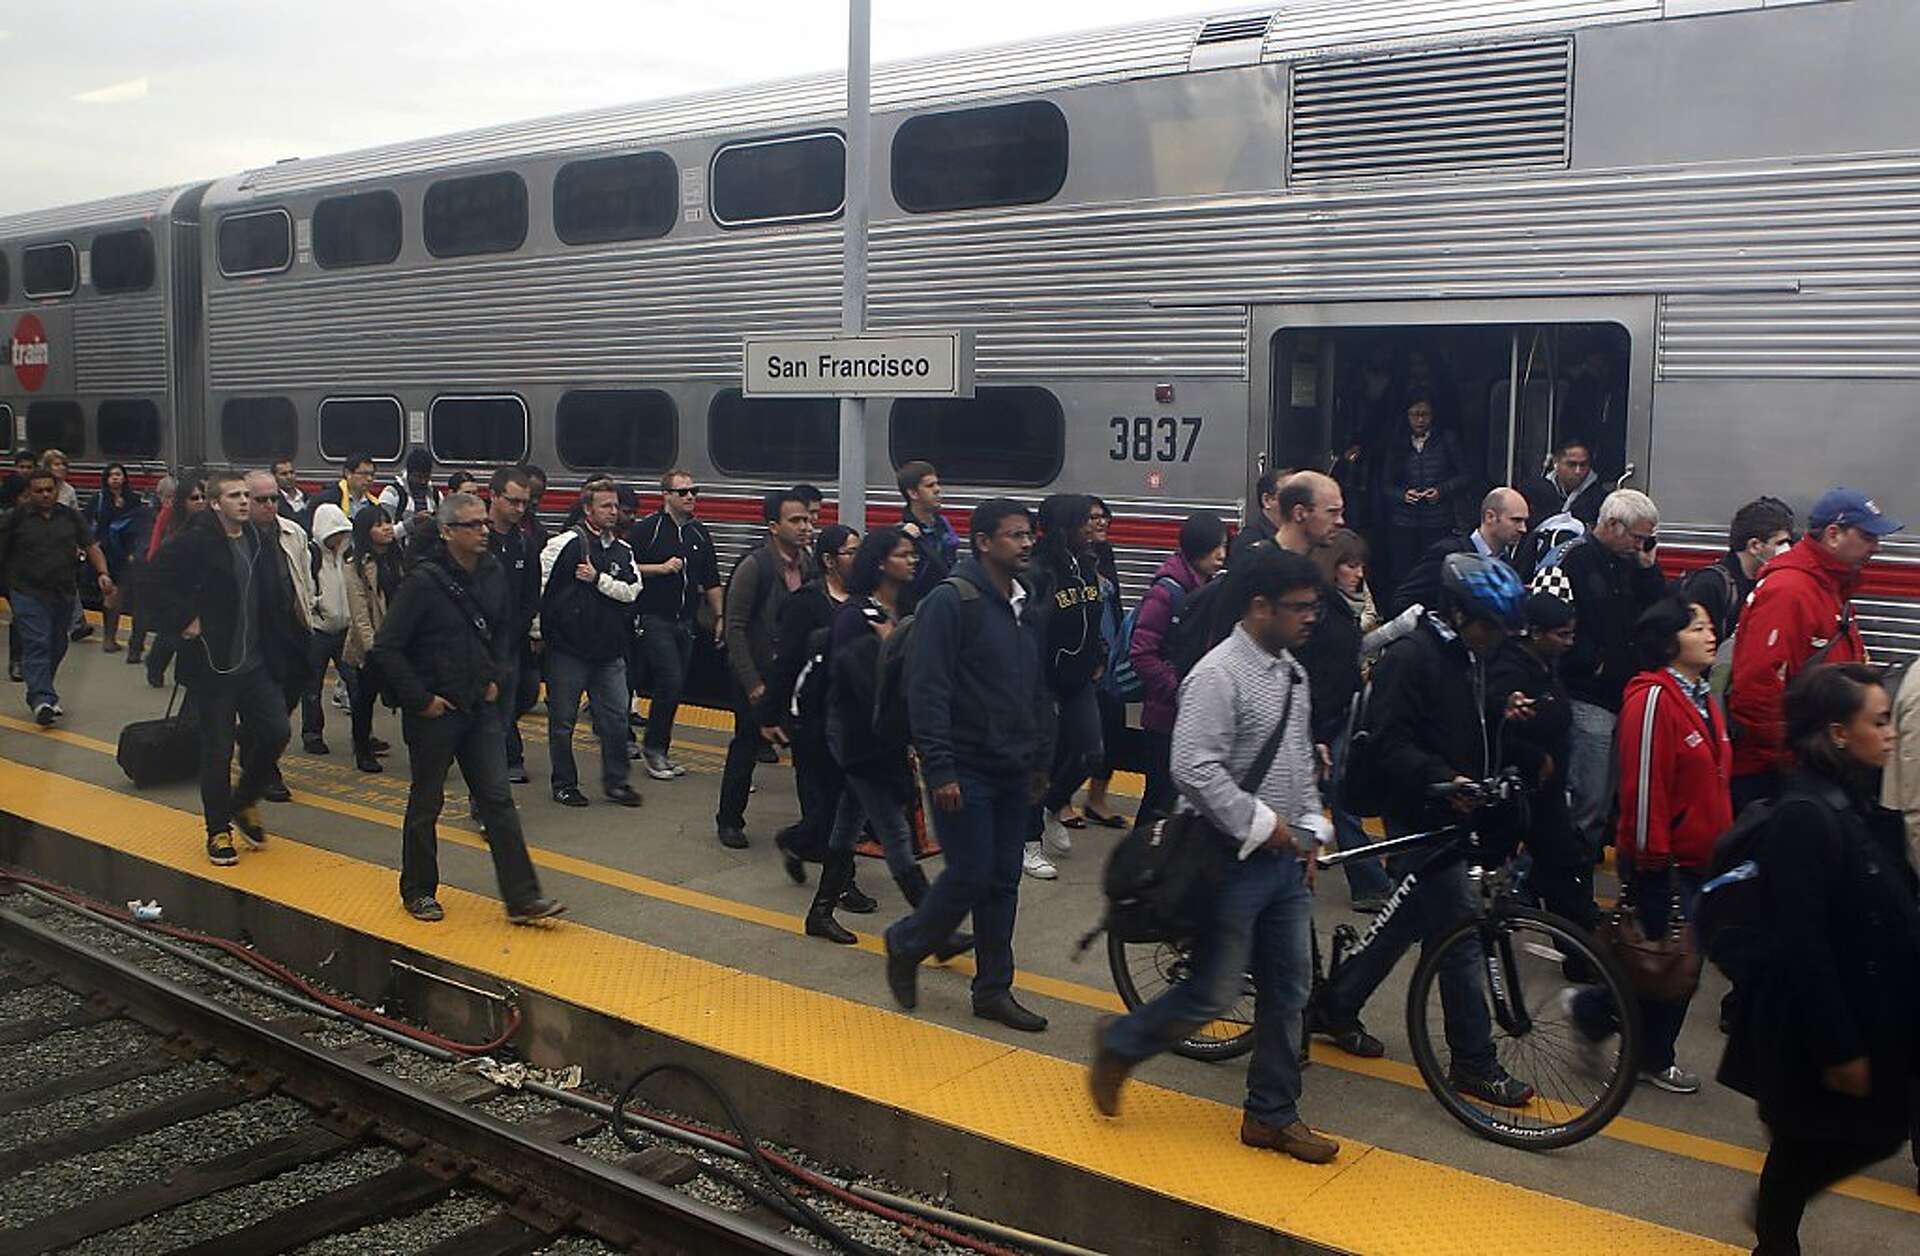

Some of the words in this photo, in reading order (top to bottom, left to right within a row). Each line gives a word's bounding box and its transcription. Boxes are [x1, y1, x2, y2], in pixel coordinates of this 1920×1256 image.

[767, 355, 807, 378] San
[818, 354, 929, 377] Francisco
[1109, 417, 1202, 462] 3837
